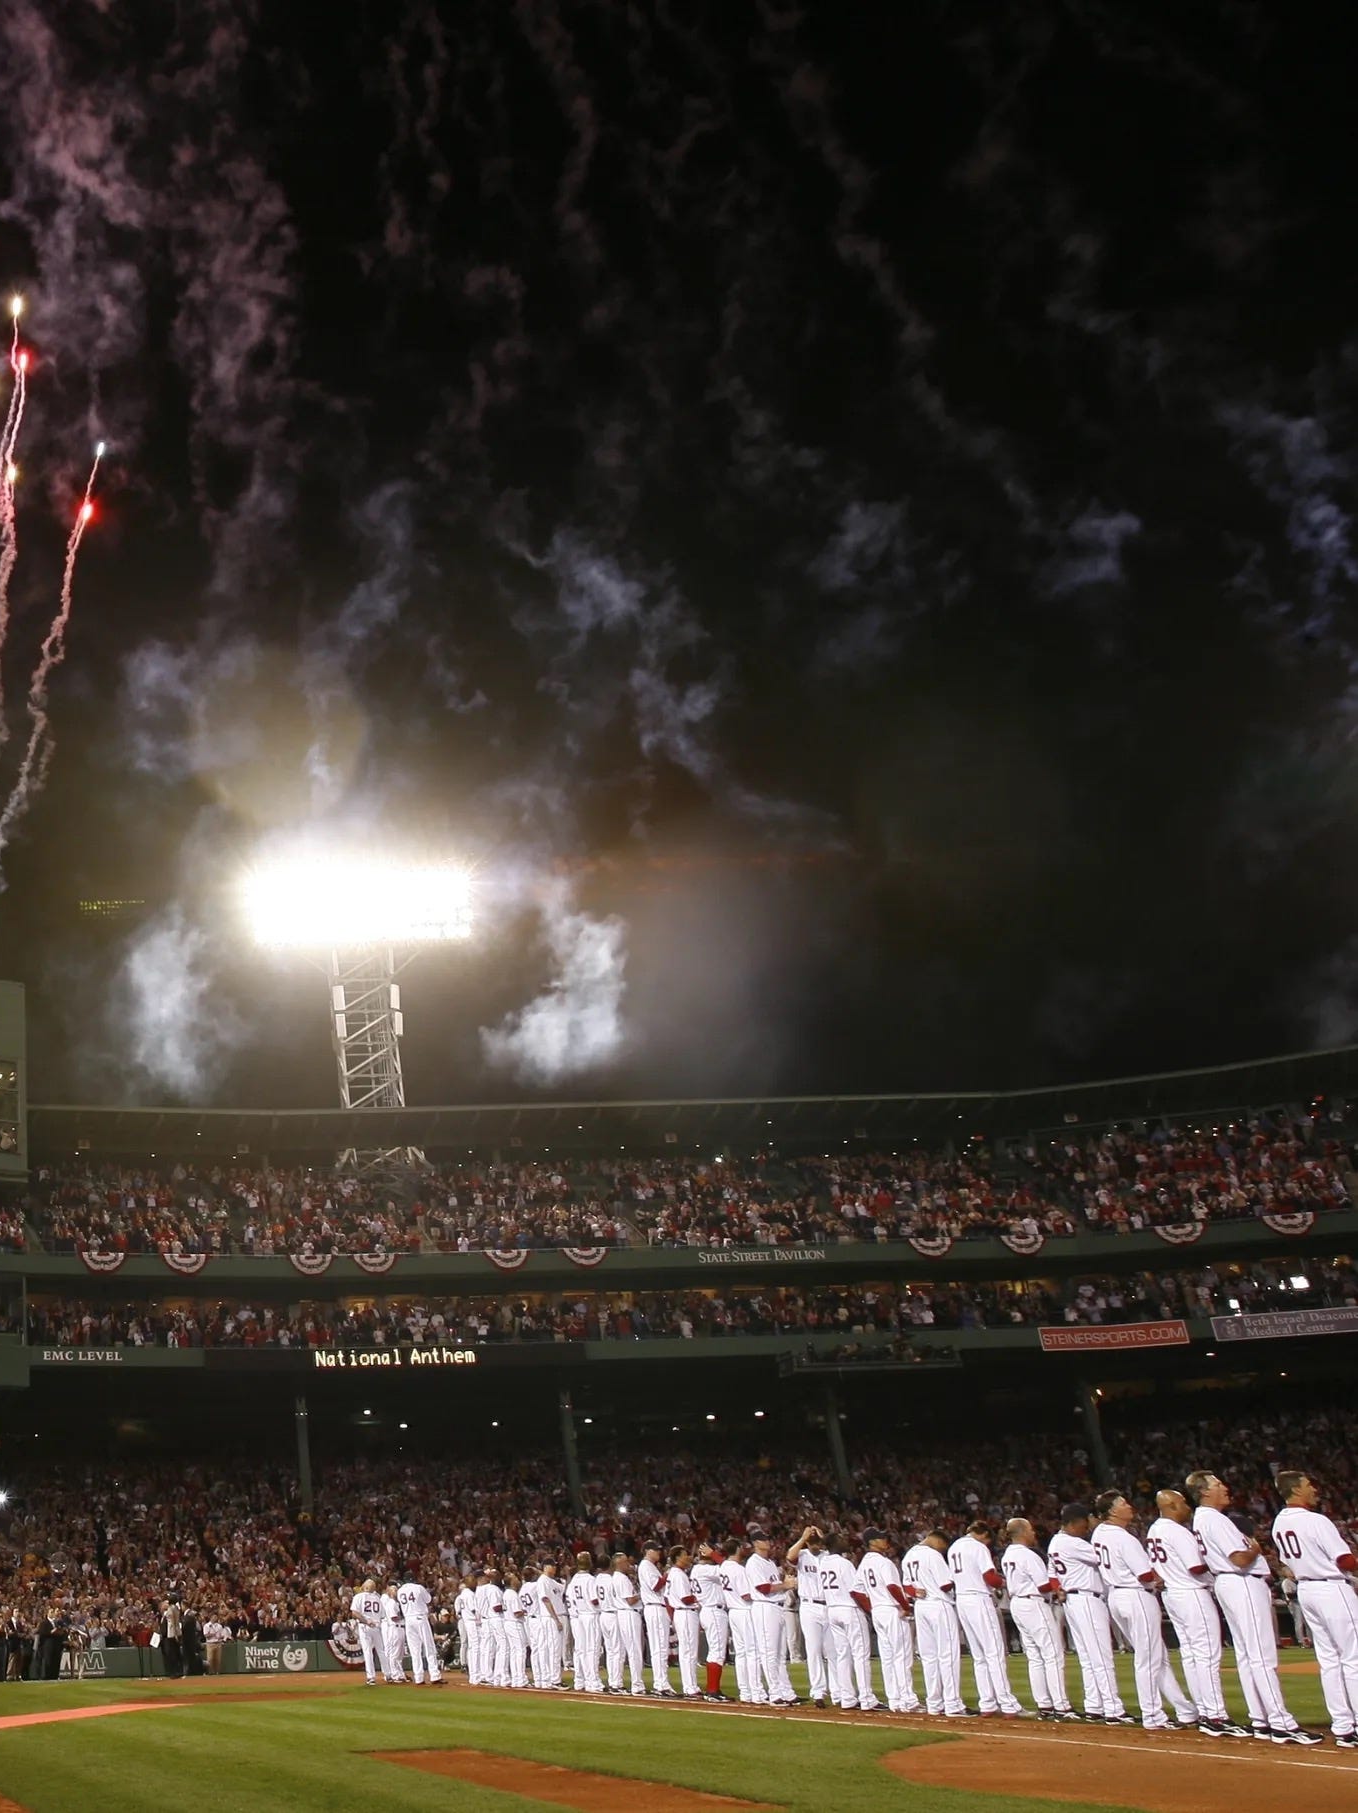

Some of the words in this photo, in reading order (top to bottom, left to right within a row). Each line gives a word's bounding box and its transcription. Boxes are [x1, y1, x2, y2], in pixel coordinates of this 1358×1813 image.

[698, 1252, 731, 1263] STATE
[732, 1250, 771, 1262] STREET
[773, 1249, 825, 1260] PAVILION
[1243, 1316, 1270, 1327] Beth
[1274, 1313, 1306, 1325] Israel
[1043, 1327, 1184, 1345] STEINERSPORTS.COM
[1247, 1324, 1293, 1337] Medical
[1297, 1322, 1335, 1333] Center
[43, 1350, 73, 1361] EMC
[78, 1351, 123, 1361] LEVEL
[315, 1349, 402, 1367] National
[410, 1347, 476, 1365] Anthem
[1145, 1538, 1168, 1563] 35
[1276, 1530, 1302, 1560] 10
[951, 1551, 963, 1574] 11
[1094, 1542, 1111, 1569] 50
[821, 1570, 840, 1590] 22
[864, 1567, 877, 1588] 18
[906, 1560, 920, 1582] 17
[364, 1600, 380, 1614] 20
[400, 1591, 416, 1605] 34
[245, 1646, 280, 1657] Ninety
[245, 1656, 280, 1669] Nine
